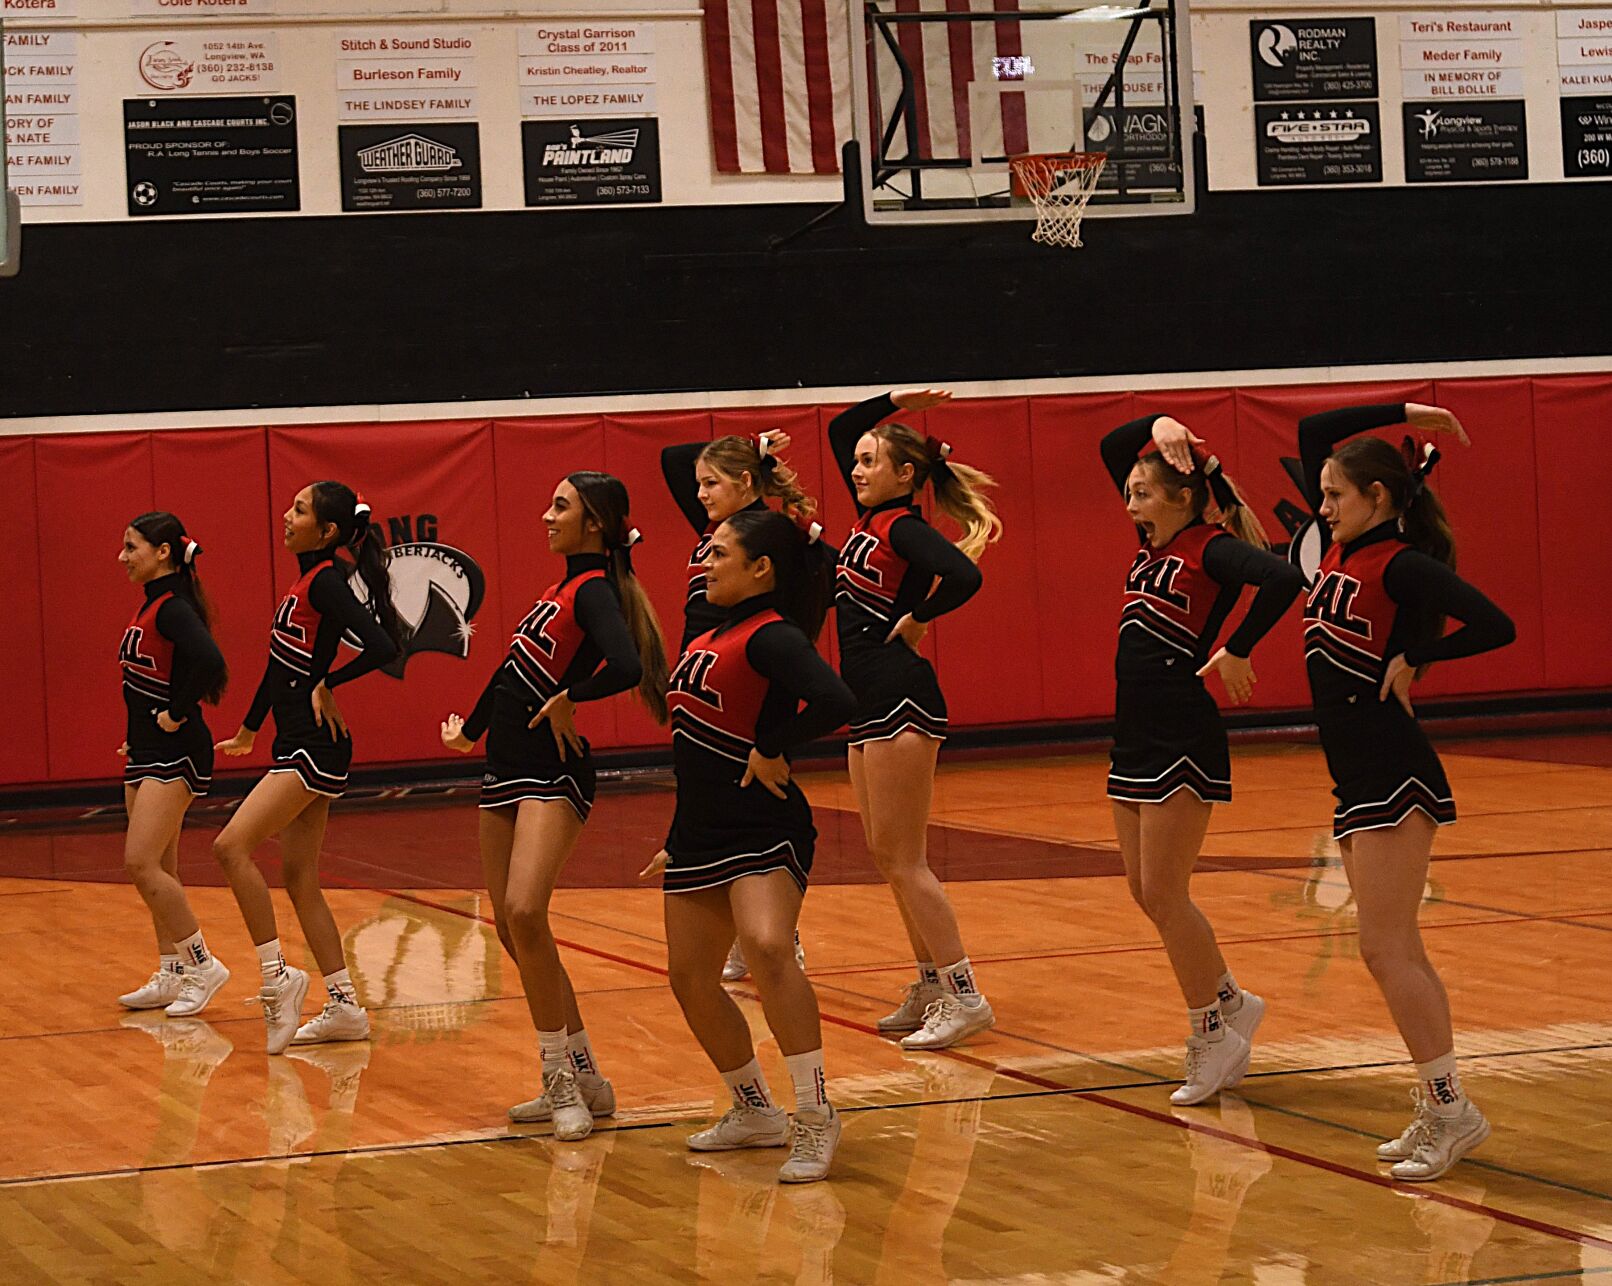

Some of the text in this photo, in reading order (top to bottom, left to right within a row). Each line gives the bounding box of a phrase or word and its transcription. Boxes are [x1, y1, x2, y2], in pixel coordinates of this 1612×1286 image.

[4, 0, 55, 8] Kotera
[1411, 21, 1512, 32] Teri's Restaurant
[538, 28, 635, 41] Crystal Garrison
[1298, 29, 1346, 39] RODMAN
[341, 37, 472, 50] Stitch & Sound Studio
[547, 42, 628, 53] Class of 2011
[1299, 40, 1340, 49] REALTY
[1085, 52, 1162, 66] The Sap Fa
[1423, 49, 1502, 62] Meder Family
[30, 66, 73, 75] FAMILY
[197, 63, 224, 73] (360)
[527, 65, 648, 76] Kristin Cheatley, Realtor
[353, 68, 461, 81] Burleson Family
[1424, 72, 1501, 82] IN MEMORY OF
[1562, 75, 1590, 84] KALEI
[1431, 85, 1497, 95] BILL BOLLIE
[28, 94, 71, 103] FAMILY
[533, 94, 644, 105] THE LOPEZ FAMILY
[345, 99, 472, 111] THE LINDSEY FAMILY
[7, 118, 54, 128] ORY OF
[193, 119, 225, 127] CASCADE
[1272, 122, 1365, 133] FIVE STAR
[17, 133, 51, 142] NATE
[168, 150, 190, 158] Long
[362, 141, 452, 167] WEATHER GUARD
[543, 149, 633, 166] PAINTLAND
[1577, 148, 1610, 168] (360)
[28, 155, 71, 165] FAMILY
[38, 186, 79, 195] FAMILY
[417, 188, 436, 199] (360)
[596, 186, 615, 196] (360)
[391, 546, 466, 579] BERJACKS
